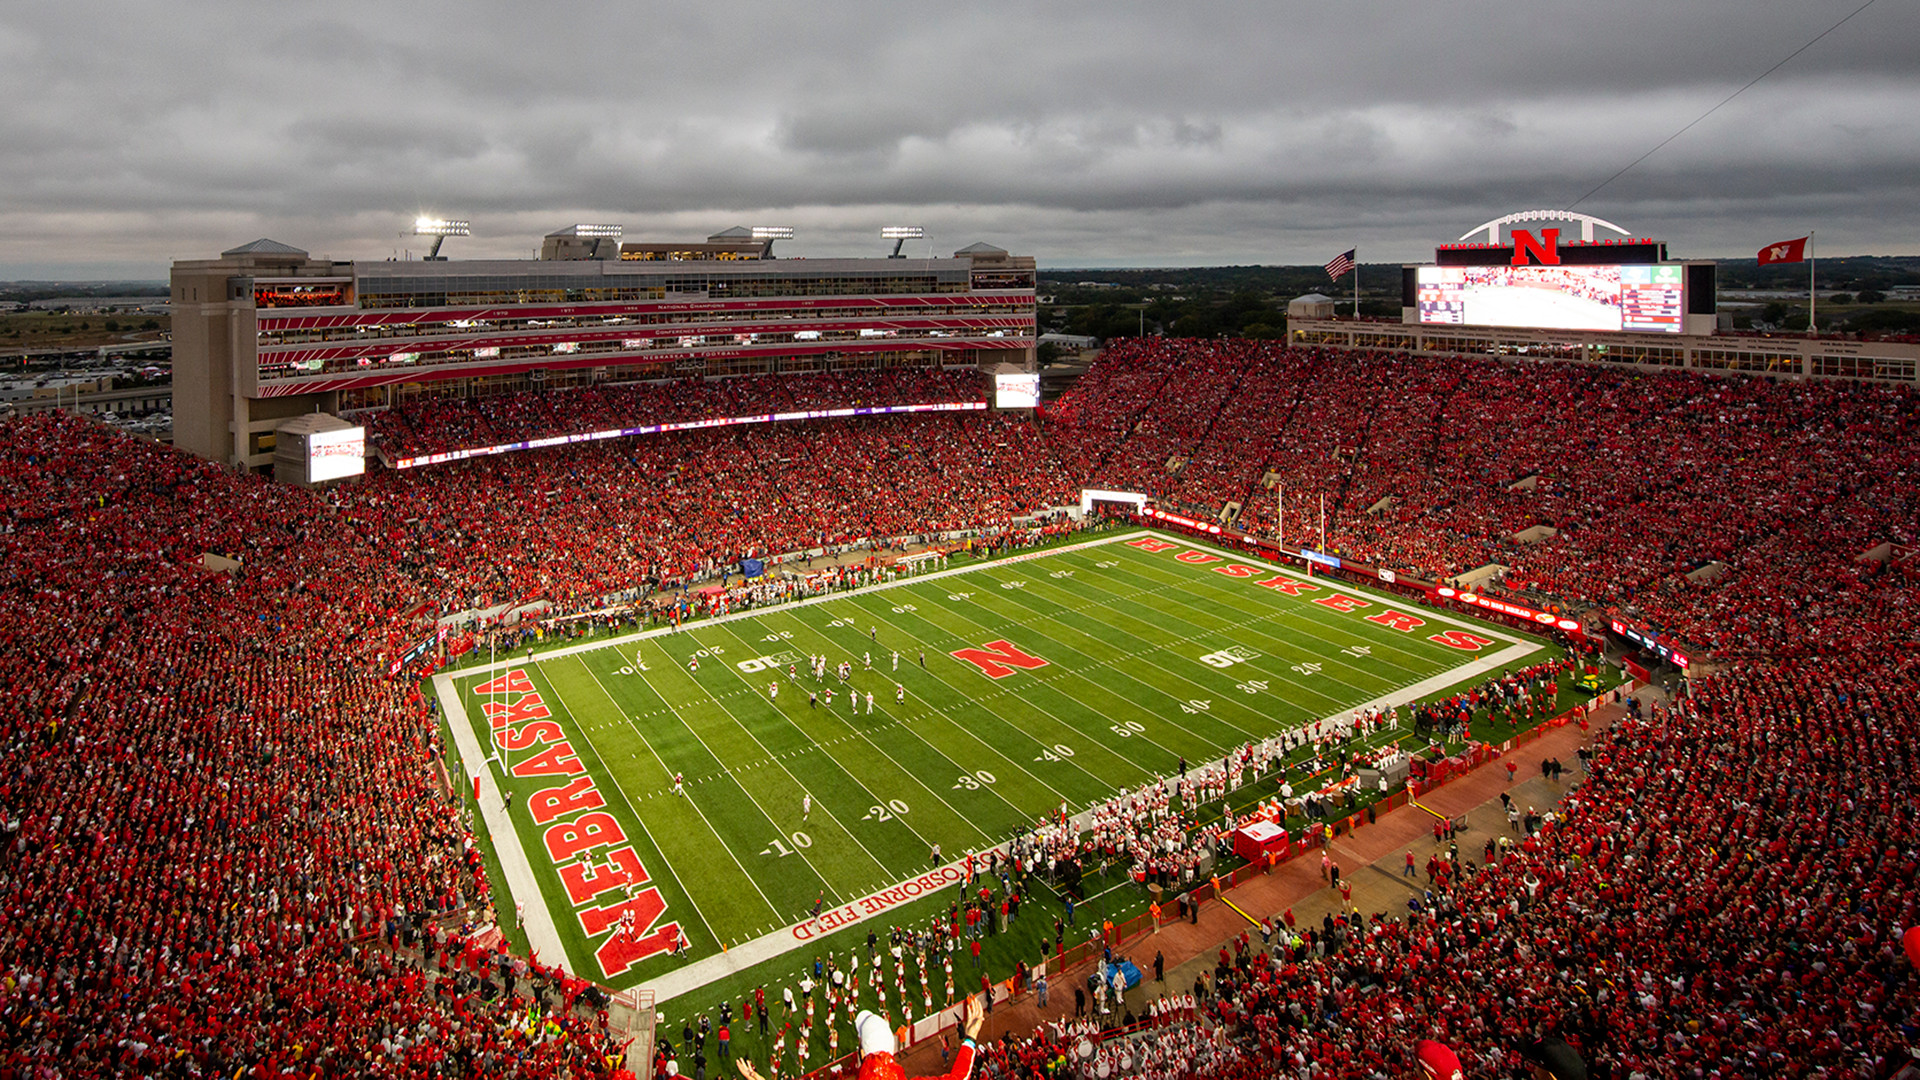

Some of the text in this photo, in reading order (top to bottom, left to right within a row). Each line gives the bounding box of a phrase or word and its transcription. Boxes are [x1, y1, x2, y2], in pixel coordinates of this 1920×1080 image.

[1440, 237, 1653, 251] MEMORIAL STADIUM
[1511, 228, 1560, 265] N
[1769, 245, 1790, 261] N
[1125, 538, 1495, 651] HUSKERS
[891, 604, 918, 614] 50
[831, 617, 855, 628] 40
[766, 631, 794, 642] 30
[696, 646, 725, 658] 20
[949, 639, 1050, 680] N
[1340, 646, 1371, 659] 10
[1291, 663, 1322, 676] 20
[1236, 680, 1268, 694] 30
[1179, 700, 1210, 715] 40
[1109, 721, 1146, 738] 50
[1042, 744, 1075, 762] 40
[958, 770, 997, 790] 30
[869, 799, 910, 823] 20
[473, 668, 692, 979] NEBRASKA
[768, 831, 812, 858] 10
[859, 867, 960, 915] OSBORNE
[792, 905, 861, 940] FIELD
